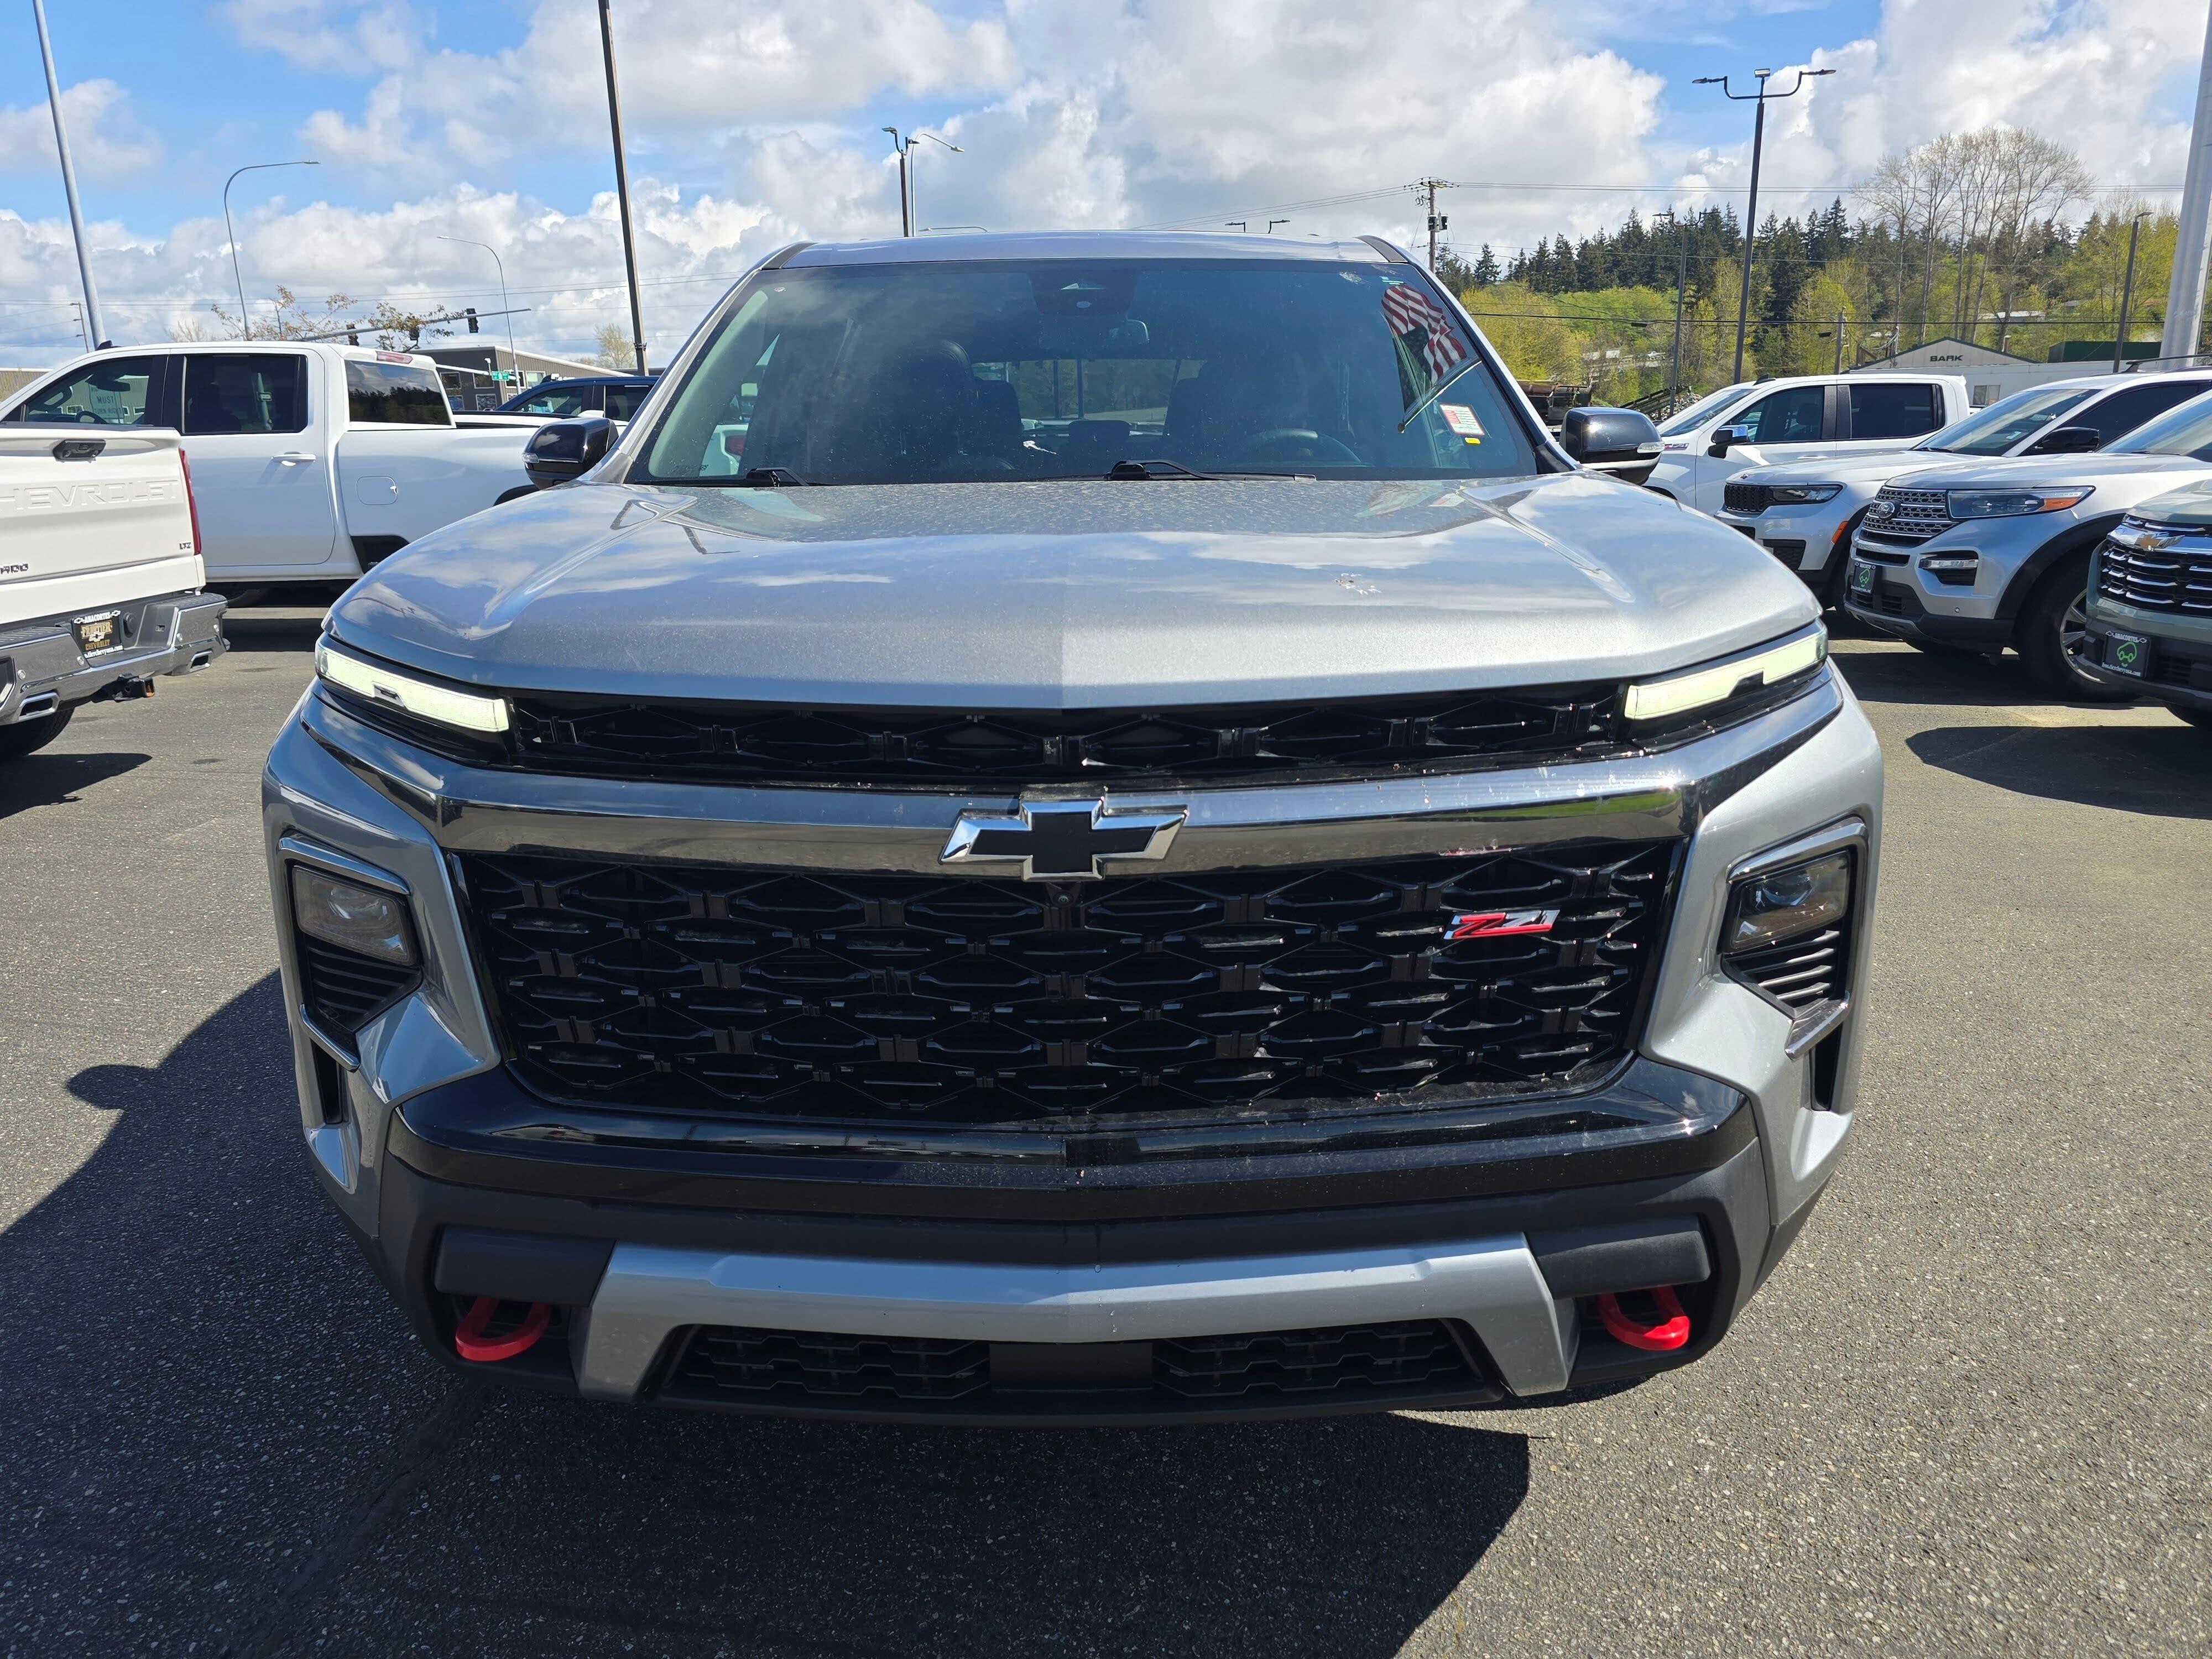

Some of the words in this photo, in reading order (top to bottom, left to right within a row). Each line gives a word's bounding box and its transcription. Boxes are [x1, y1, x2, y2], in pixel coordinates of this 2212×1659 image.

[96, 396, 114, 404] MUST
[83, 612, 111, 623] ANACORTES
[2114, 633, 2139, 643] ANACORTES
[1443, 910, 1560, 940] Z71
